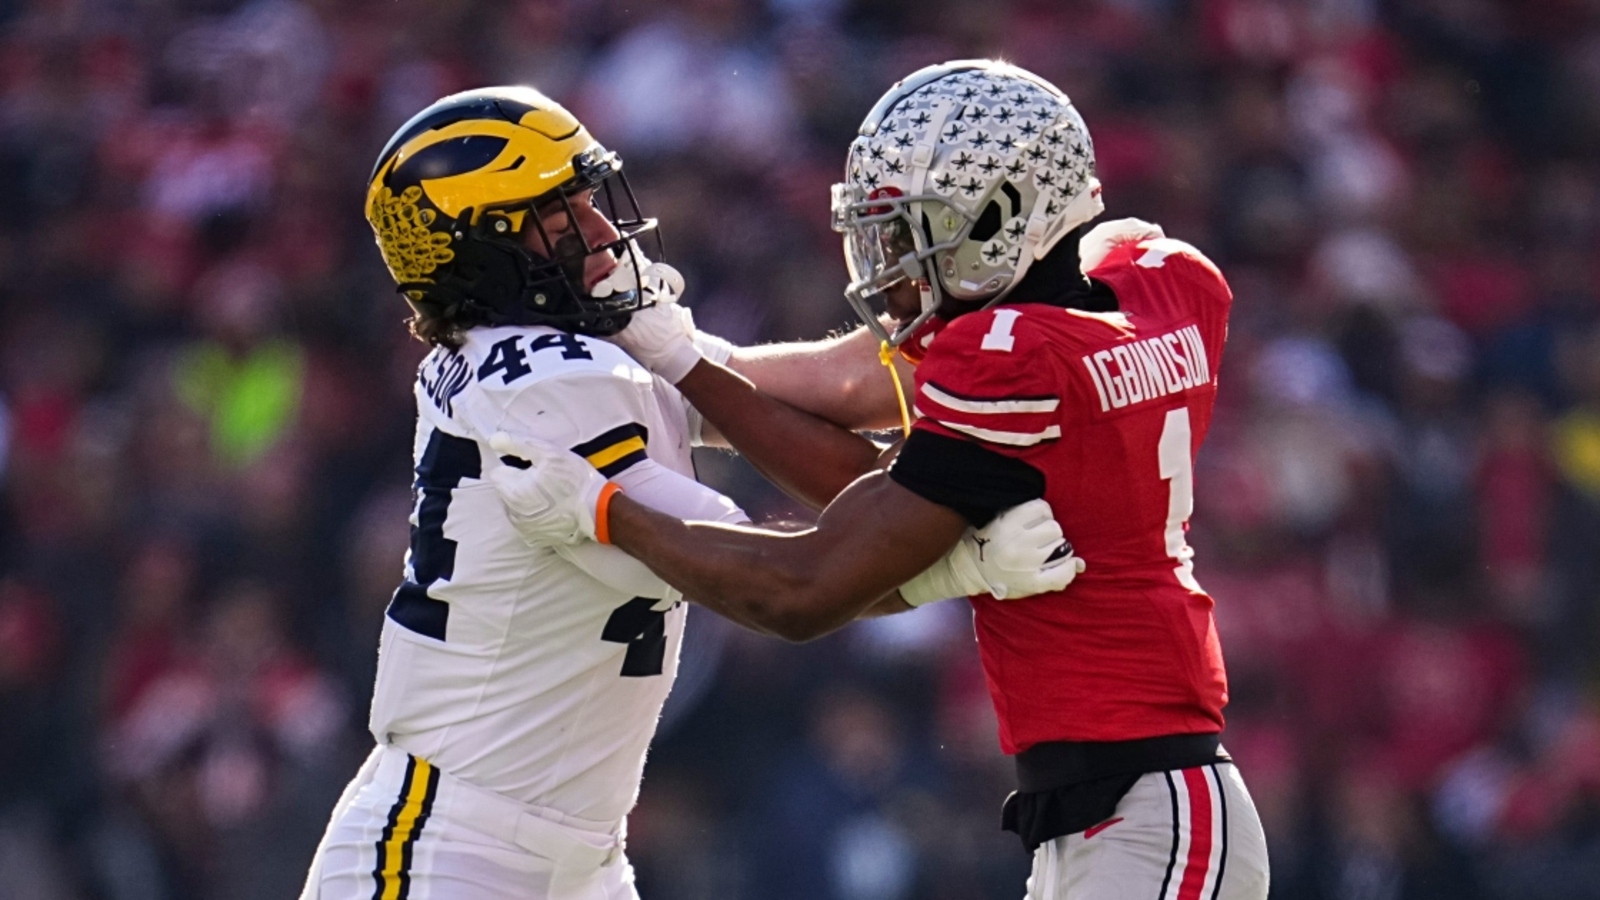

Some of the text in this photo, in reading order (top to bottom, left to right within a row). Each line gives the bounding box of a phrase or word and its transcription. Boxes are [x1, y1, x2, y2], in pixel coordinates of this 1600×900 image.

[477, 333, 593, 385] 44
[981, 308, 1023, 352] 1
[1082, 324, 1210, 412] IGBINOSUN
[1158, 407, 1206, 595] 1
